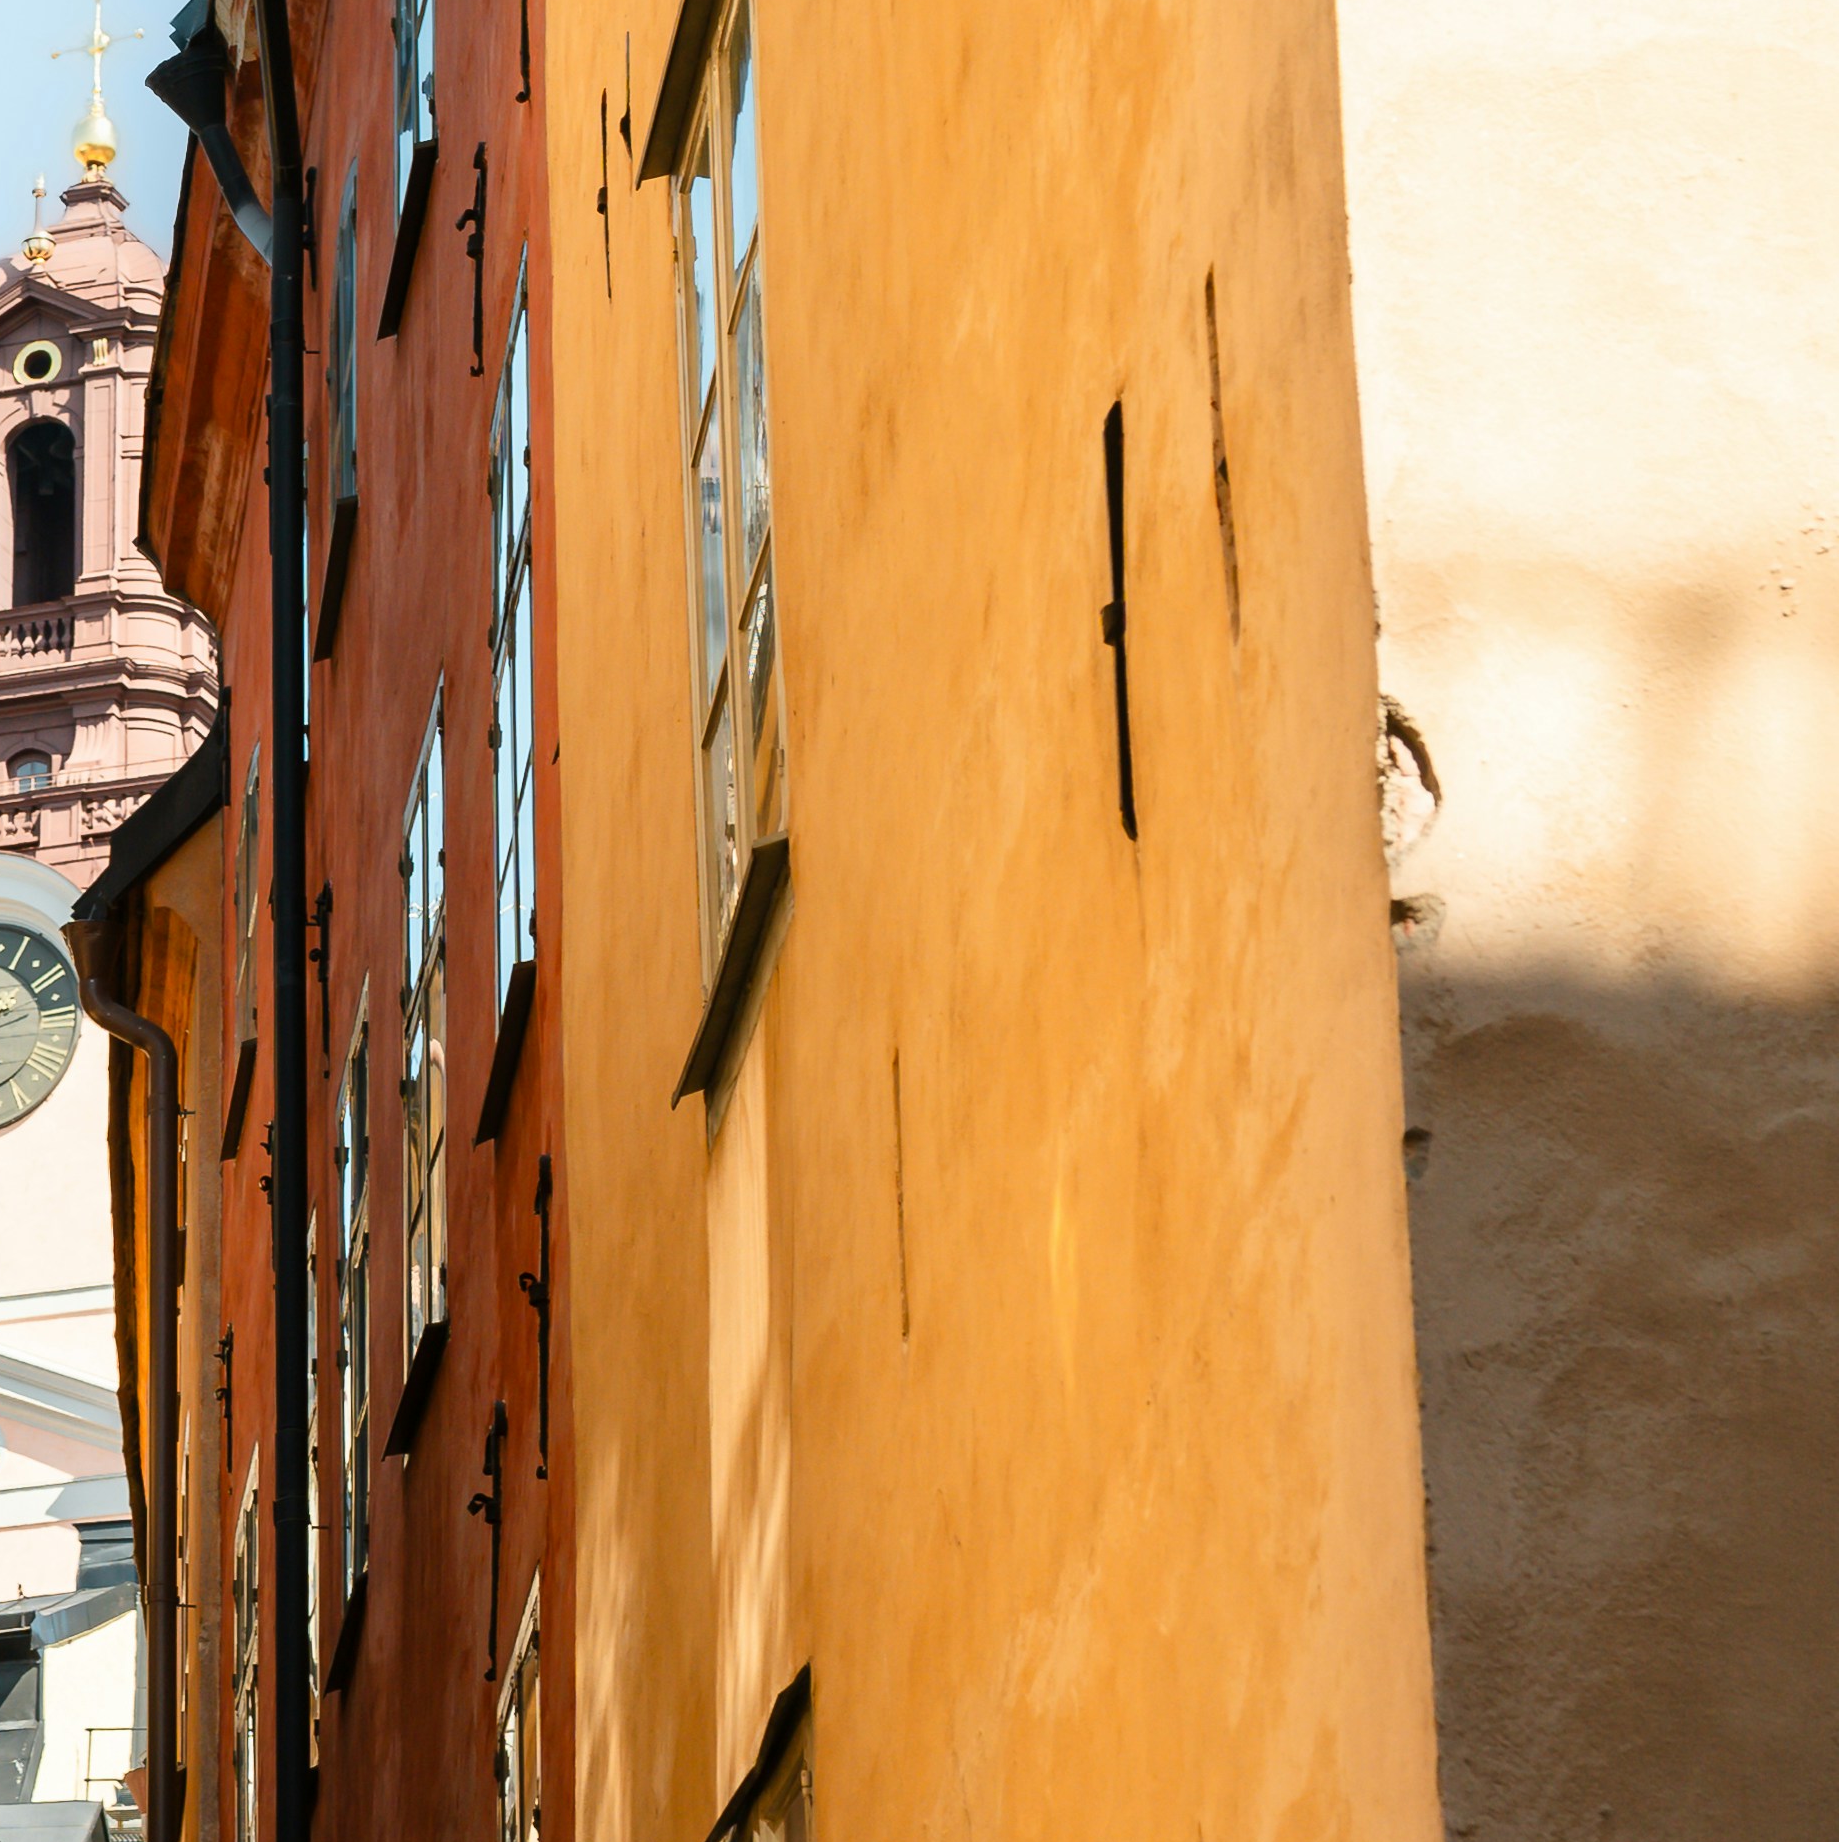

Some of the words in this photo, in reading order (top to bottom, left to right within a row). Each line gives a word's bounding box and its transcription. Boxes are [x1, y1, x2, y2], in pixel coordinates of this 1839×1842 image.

[8, 935, 31, 971] I
[30, 962, 66, 995] II
[40, 1003, 76, 1030] III
[9, 1078, 32, 1110] V
